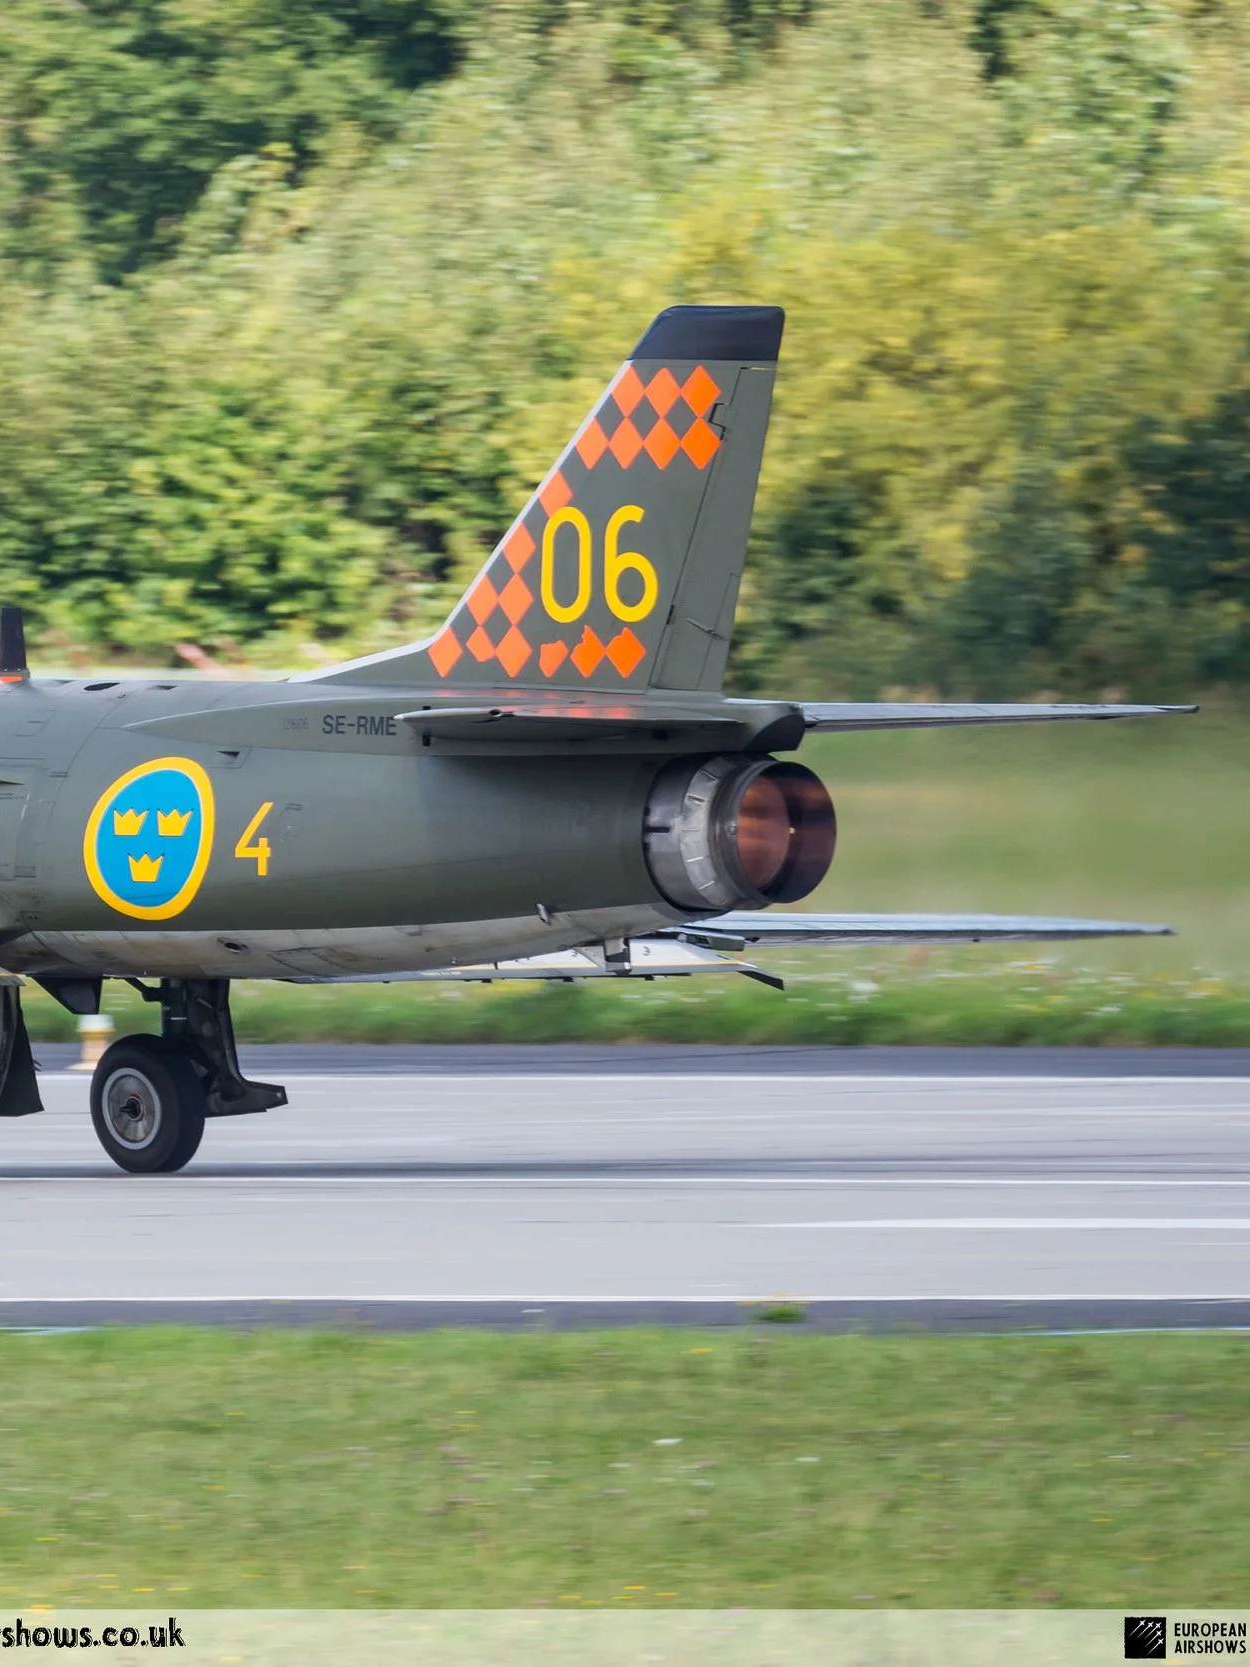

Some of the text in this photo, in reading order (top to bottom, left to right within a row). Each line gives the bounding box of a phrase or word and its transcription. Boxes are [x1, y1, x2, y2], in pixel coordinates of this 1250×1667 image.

[541, 504, 658, 624] 06
[321, 714, 397, 736] SE-RME
[234, 801, 274, 876] 4
